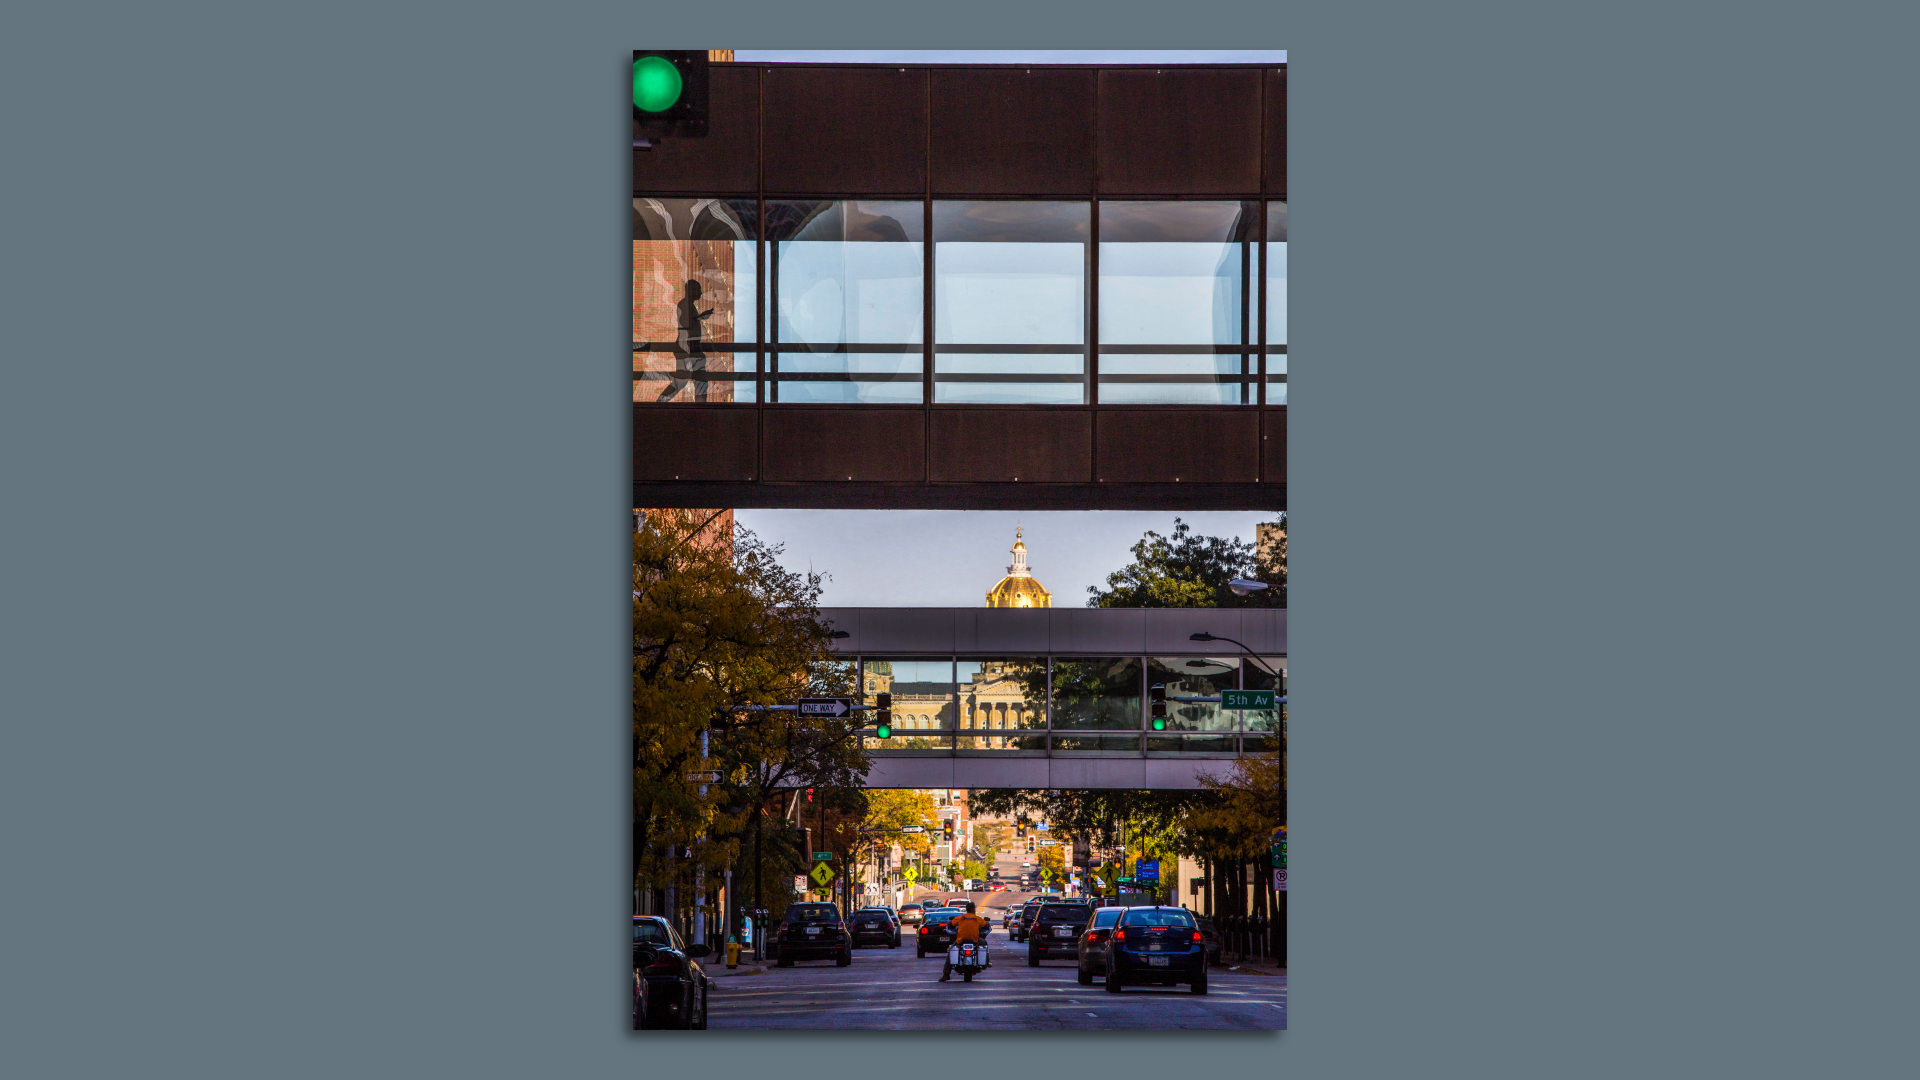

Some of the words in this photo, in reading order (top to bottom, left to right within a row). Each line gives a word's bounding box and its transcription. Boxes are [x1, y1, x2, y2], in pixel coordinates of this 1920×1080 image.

[1228, 695, 1248, 705] 5th
[1254, 695, 1268, 705] Av
[803, 704, 818, 712] ONE
[819, 704, 835, 712] WAY
